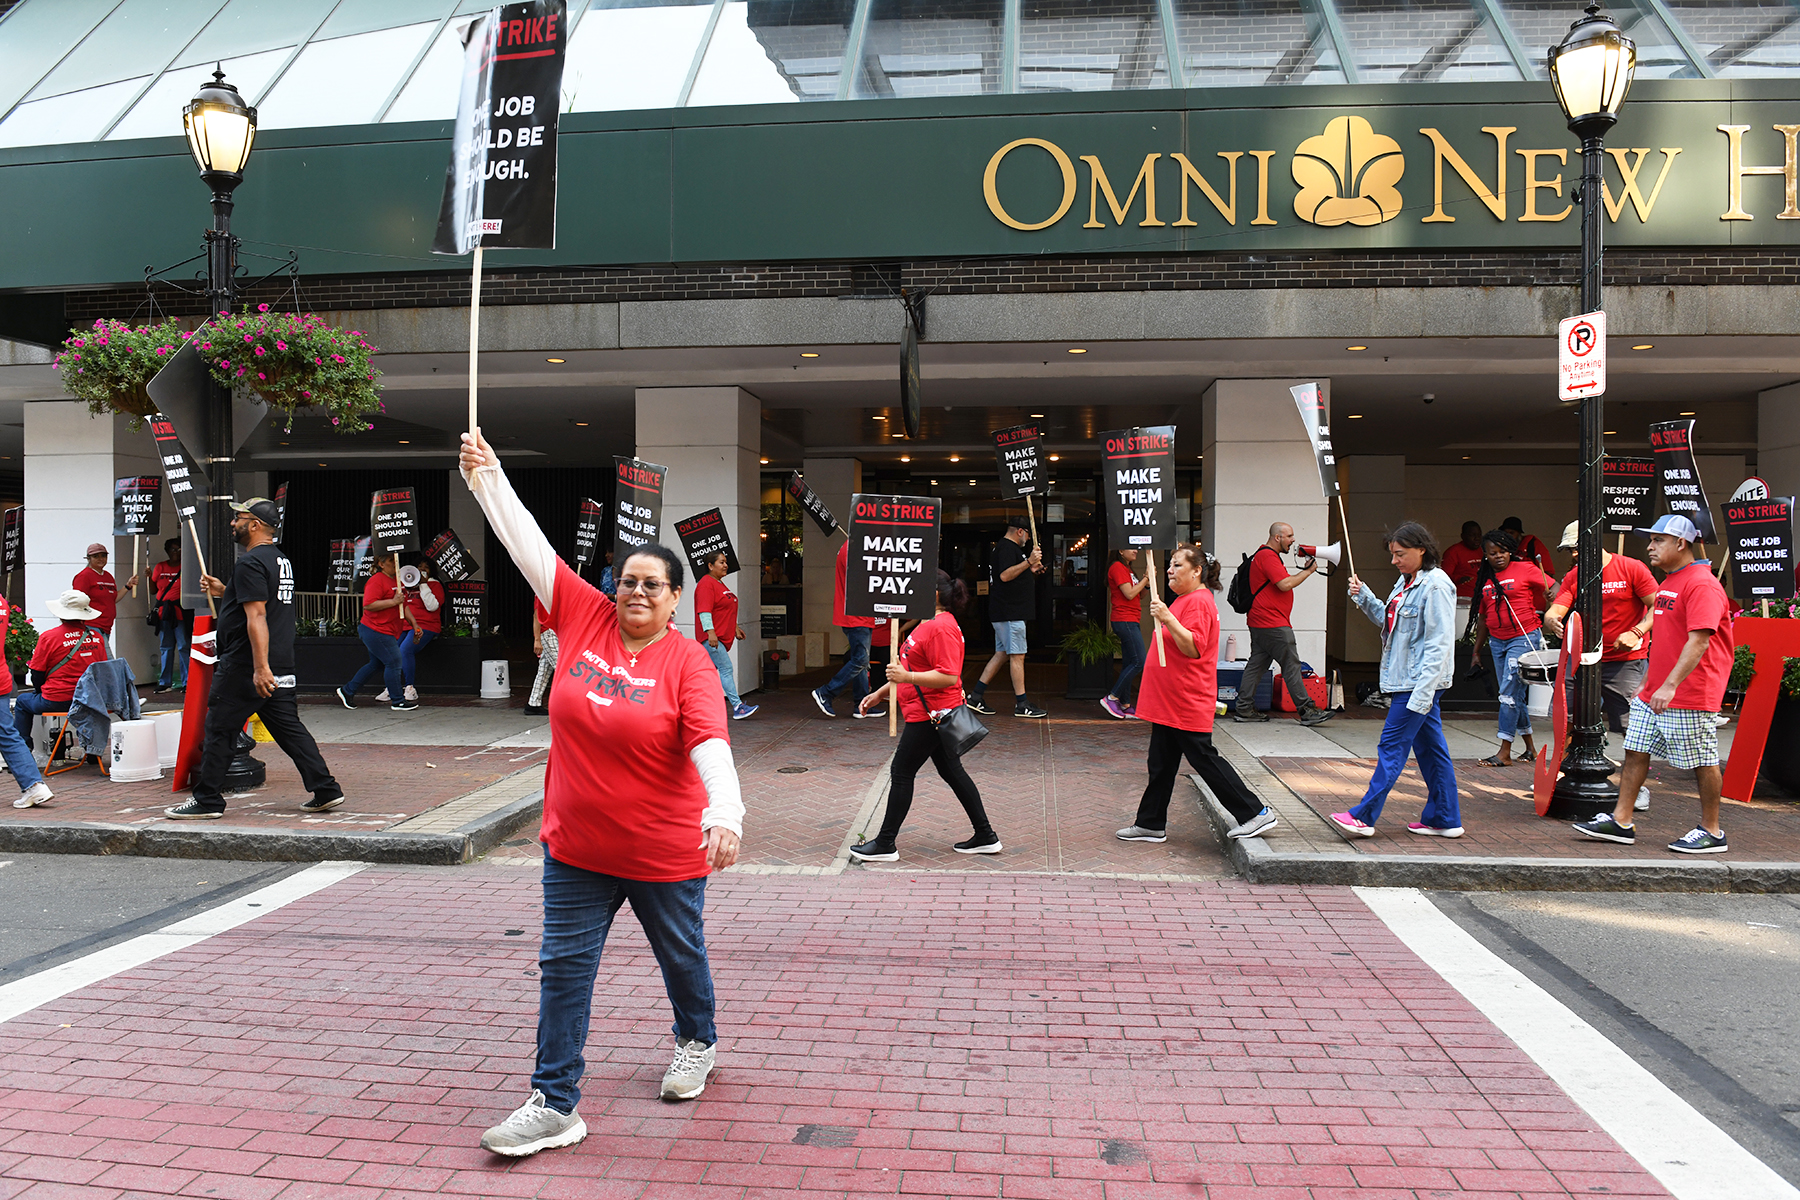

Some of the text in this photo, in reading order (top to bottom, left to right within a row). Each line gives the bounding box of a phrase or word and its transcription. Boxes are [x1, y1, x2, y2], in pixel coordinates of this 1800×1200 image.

[494, 95, 535, 117] JOB
[516, 126, 545, 147] BE
[983, 137, 1278, 231] OMNI
[1419, 126, 1683, 223] NEW
[1562, 359, 1602, 373] No Parking
[1569, 370, 1595, 380] Anytime
[996, 426, 1038, 443] ON STRIKE
[1651, 429, 1687, 446] ON STRIKE
[1106, 434, 1169, 453] ON STRIKE
[1004, 446, 1036, 461] MAKE
[1006, 458, 1038, 472] THEM
[1603, 462, 1655, 472] ON STRIKE
[618, 463, 661, 487] ON STRIKE
[1012, 470, 1037, 484] PAY.
[1116, 467, 1161, 485] MAKE
[1664, 468, 1691, 480] ONE JOB
[131, 478, 159, 486] STRIKE
[382, 491, 411, 501] STRIKE
[1117, 488, 1162, 505] THEM
[1602, 486, 1650, 495] RESPECT
[1664, 485, 1689, 496] SHOULD
[1732, 485, 1764, 502] NITE
[122, 494, 153, 503] MAKE
[1613, 497, 1636, 505] OUR
[1670, 500, 1701, 512] ENOUGH.
[121, 504, 153, 513] THEM
[620, 500, 652, 519] ONE JOB
[856, 502, 935, 519] ON STRIKE
[1606, 507, 1641, 516] WORK.
[1728, 503, 1787, 519] ON STRIKE
[124, 514, 149, 524] PAY.
[377, 512, 408, 521] ONE JOB
[679, 512, 719, 533] ON STRIKE
[1123, 508, 1157, 526] PAY.
[374, 521, 402, 530] SHOULD
[617, 513, 656, 537] SHOULD BE
[378, 528, 410, 538] ENOUGH.
[425, 530, 453, 557] ON STRIKE
[691, 534, 721, 549] ONE JOB
[863, 535, 922, 553] MAKE
[1740, 536, 1781, 547] ONE JOB
[436, 544, 457, 566] MAKE
[690, 545, 718, 559] SHOULD
[718, 541, 728, 549] BE
[1735, 549, 1788, 560] SHOULD BE
[441, 551, 463, 572] THEM
[862, 555, 922, 573] THEM
[1741, 563, 1784, 573] ENOUGH.
[448, 561, 466, 579] PAY.
[868, 575, 913, 595] PAY.
[453, 597, 480, 606] MAKE
[453, 607, 480, 615] THEM
[582, 649, 611, 674] HOTEL
[569, 661, 651, 704] STRIKE
